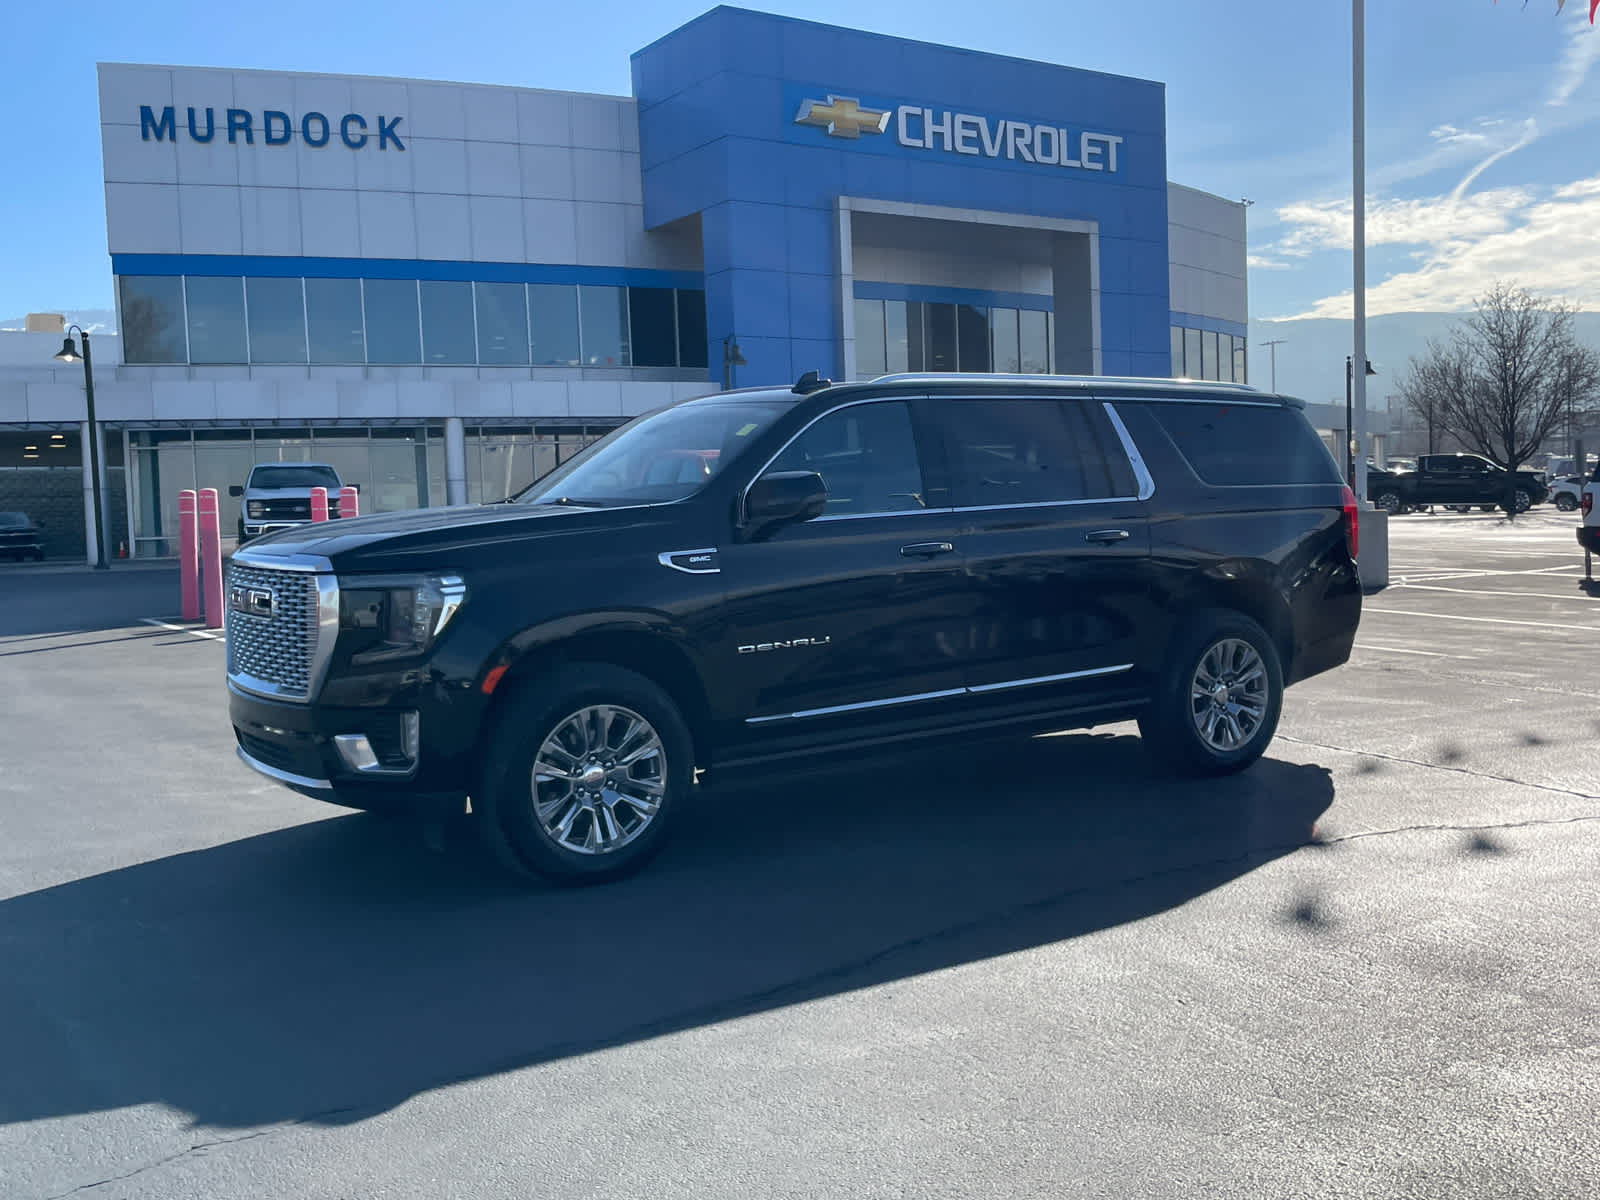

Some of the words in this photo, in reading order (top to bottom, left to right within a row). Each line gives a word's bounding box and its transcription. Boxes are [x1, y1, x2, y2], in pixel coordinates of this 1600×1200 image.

[139, 104, 406, 152] MURDOCK
[898, 104, 1123, 173] CHEVROLET
[738, 635, 830, 653] DENALI
